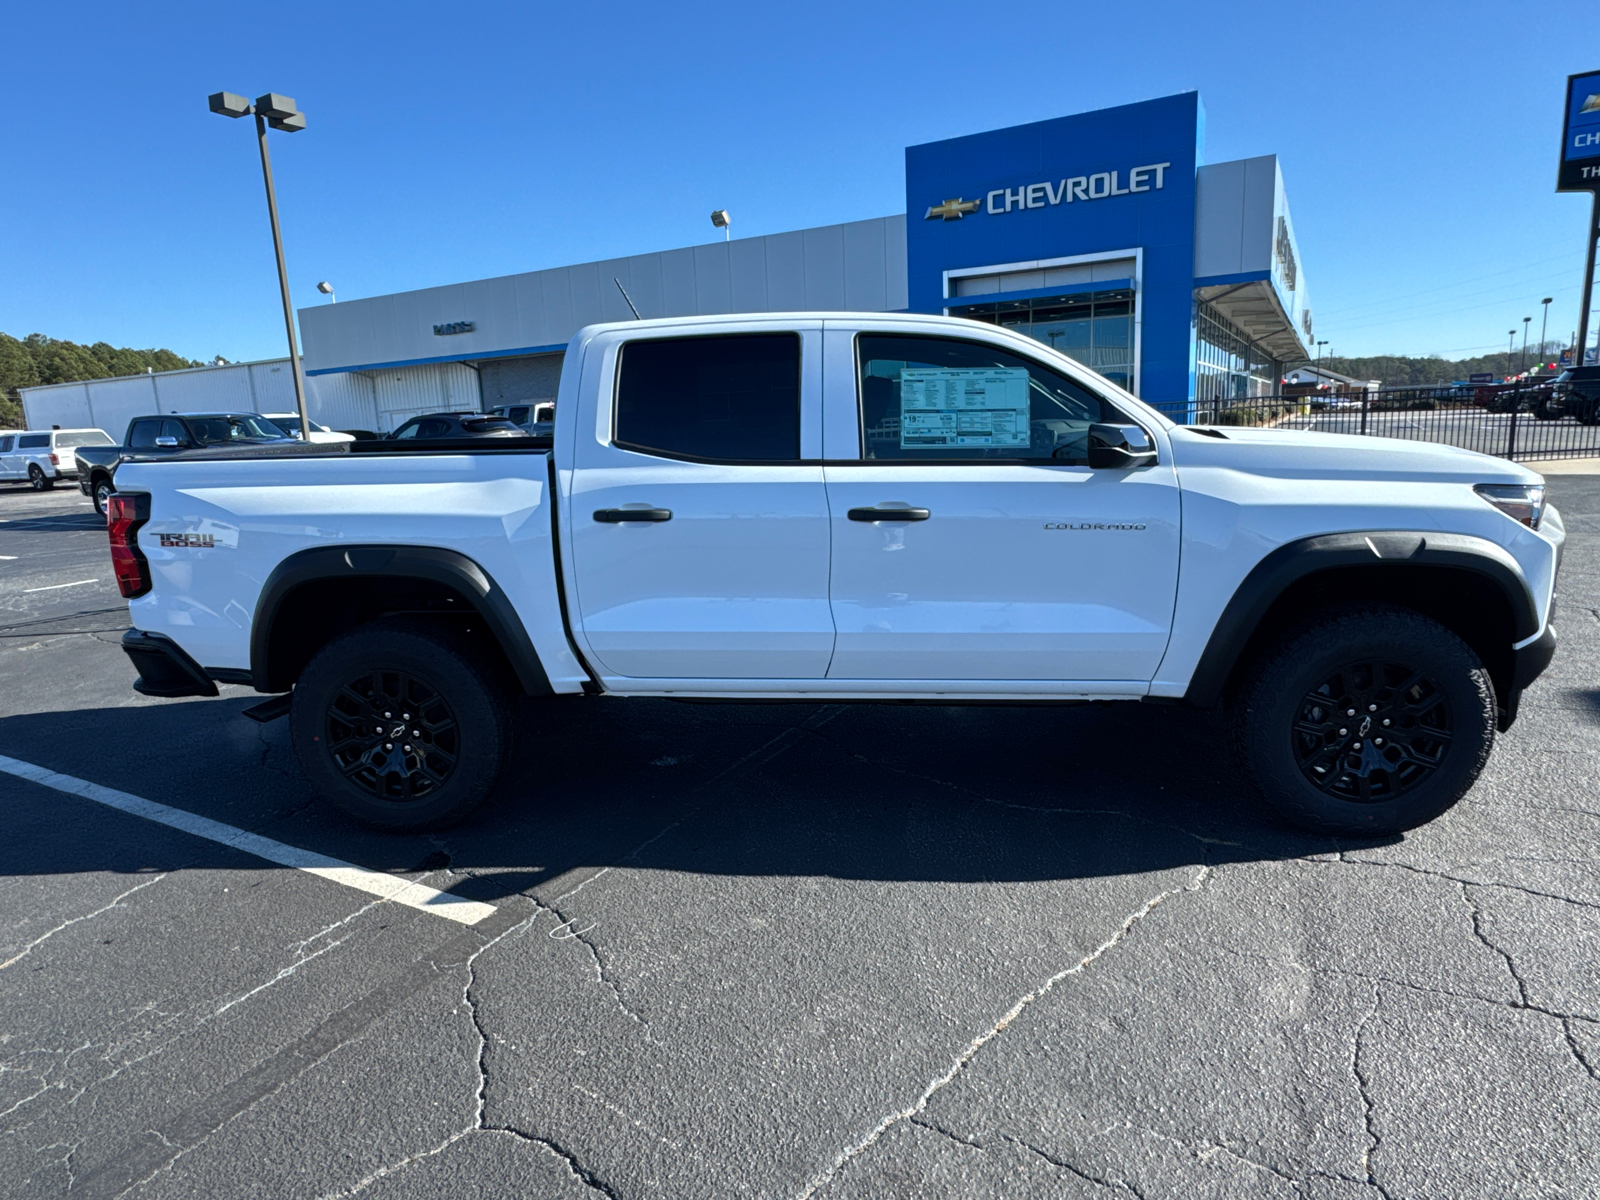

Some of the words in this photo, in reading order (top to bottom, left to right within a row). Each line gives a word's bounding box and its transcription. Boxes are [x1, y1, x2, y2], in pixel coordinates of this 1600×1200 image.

[986, 161, 1171, 215] CHEVROLET
[1043, 522, 1146, 531] COLORADO
[150, 533, 222, 542] TRAIL
